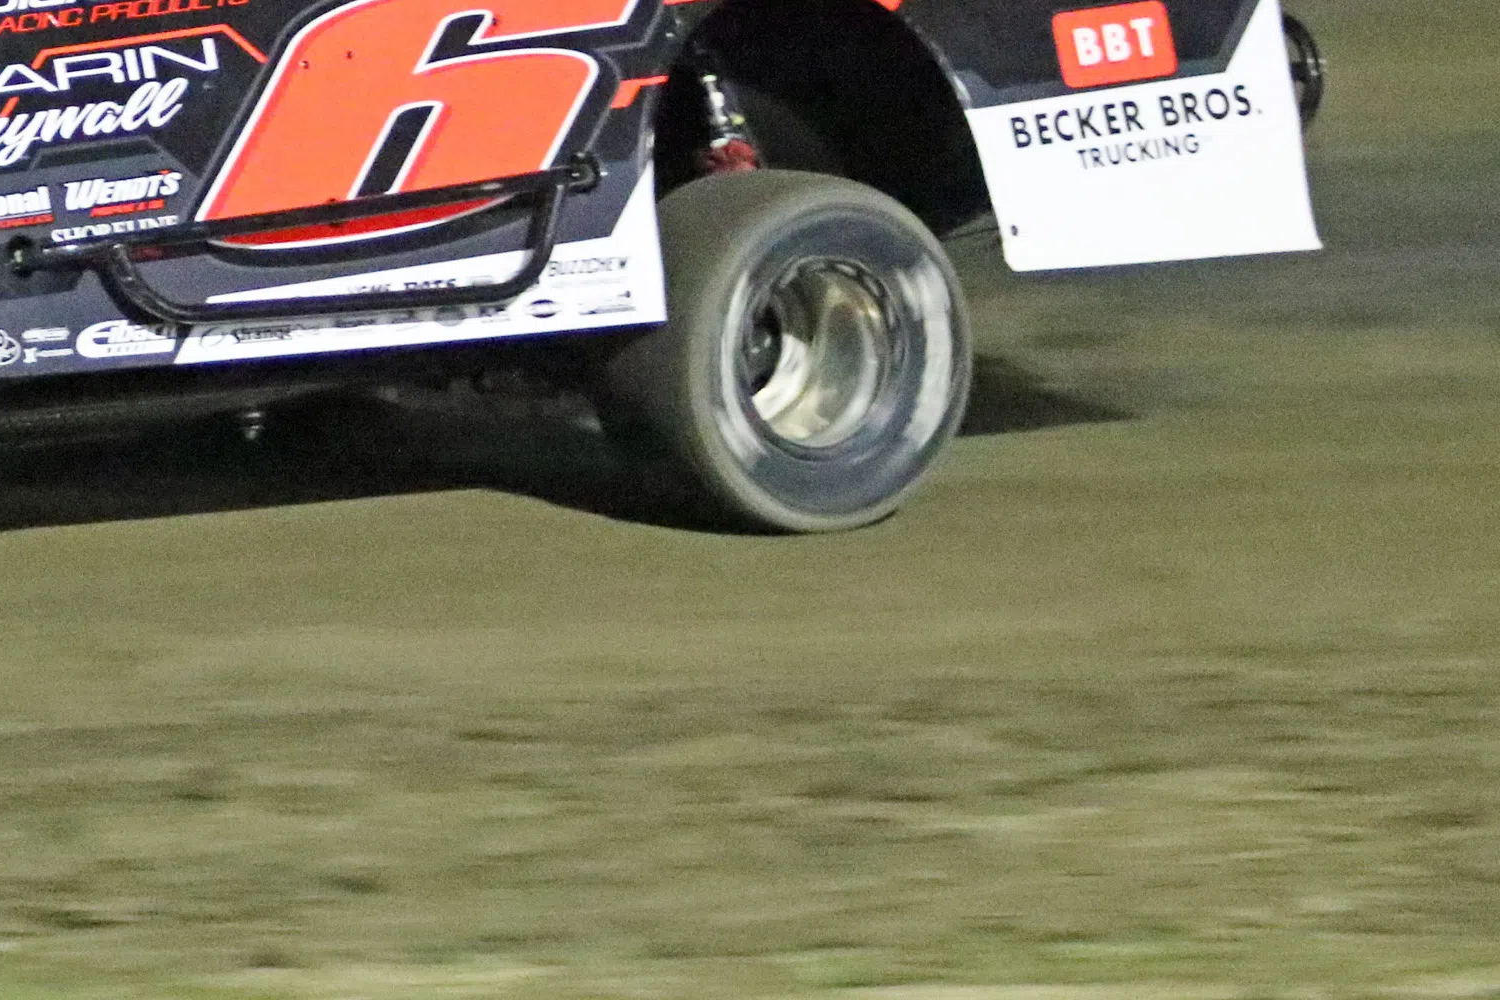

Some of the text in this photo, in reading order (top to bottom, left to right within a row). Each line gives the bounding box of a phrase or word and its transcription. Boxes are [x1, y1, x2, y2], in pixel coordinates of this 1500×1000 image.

[1071, 17, 1157, 68] BBT
[1010, 84, 1264, 150] BECKER BROS.
[1077, 132, 1201, 170] TRUCKING
